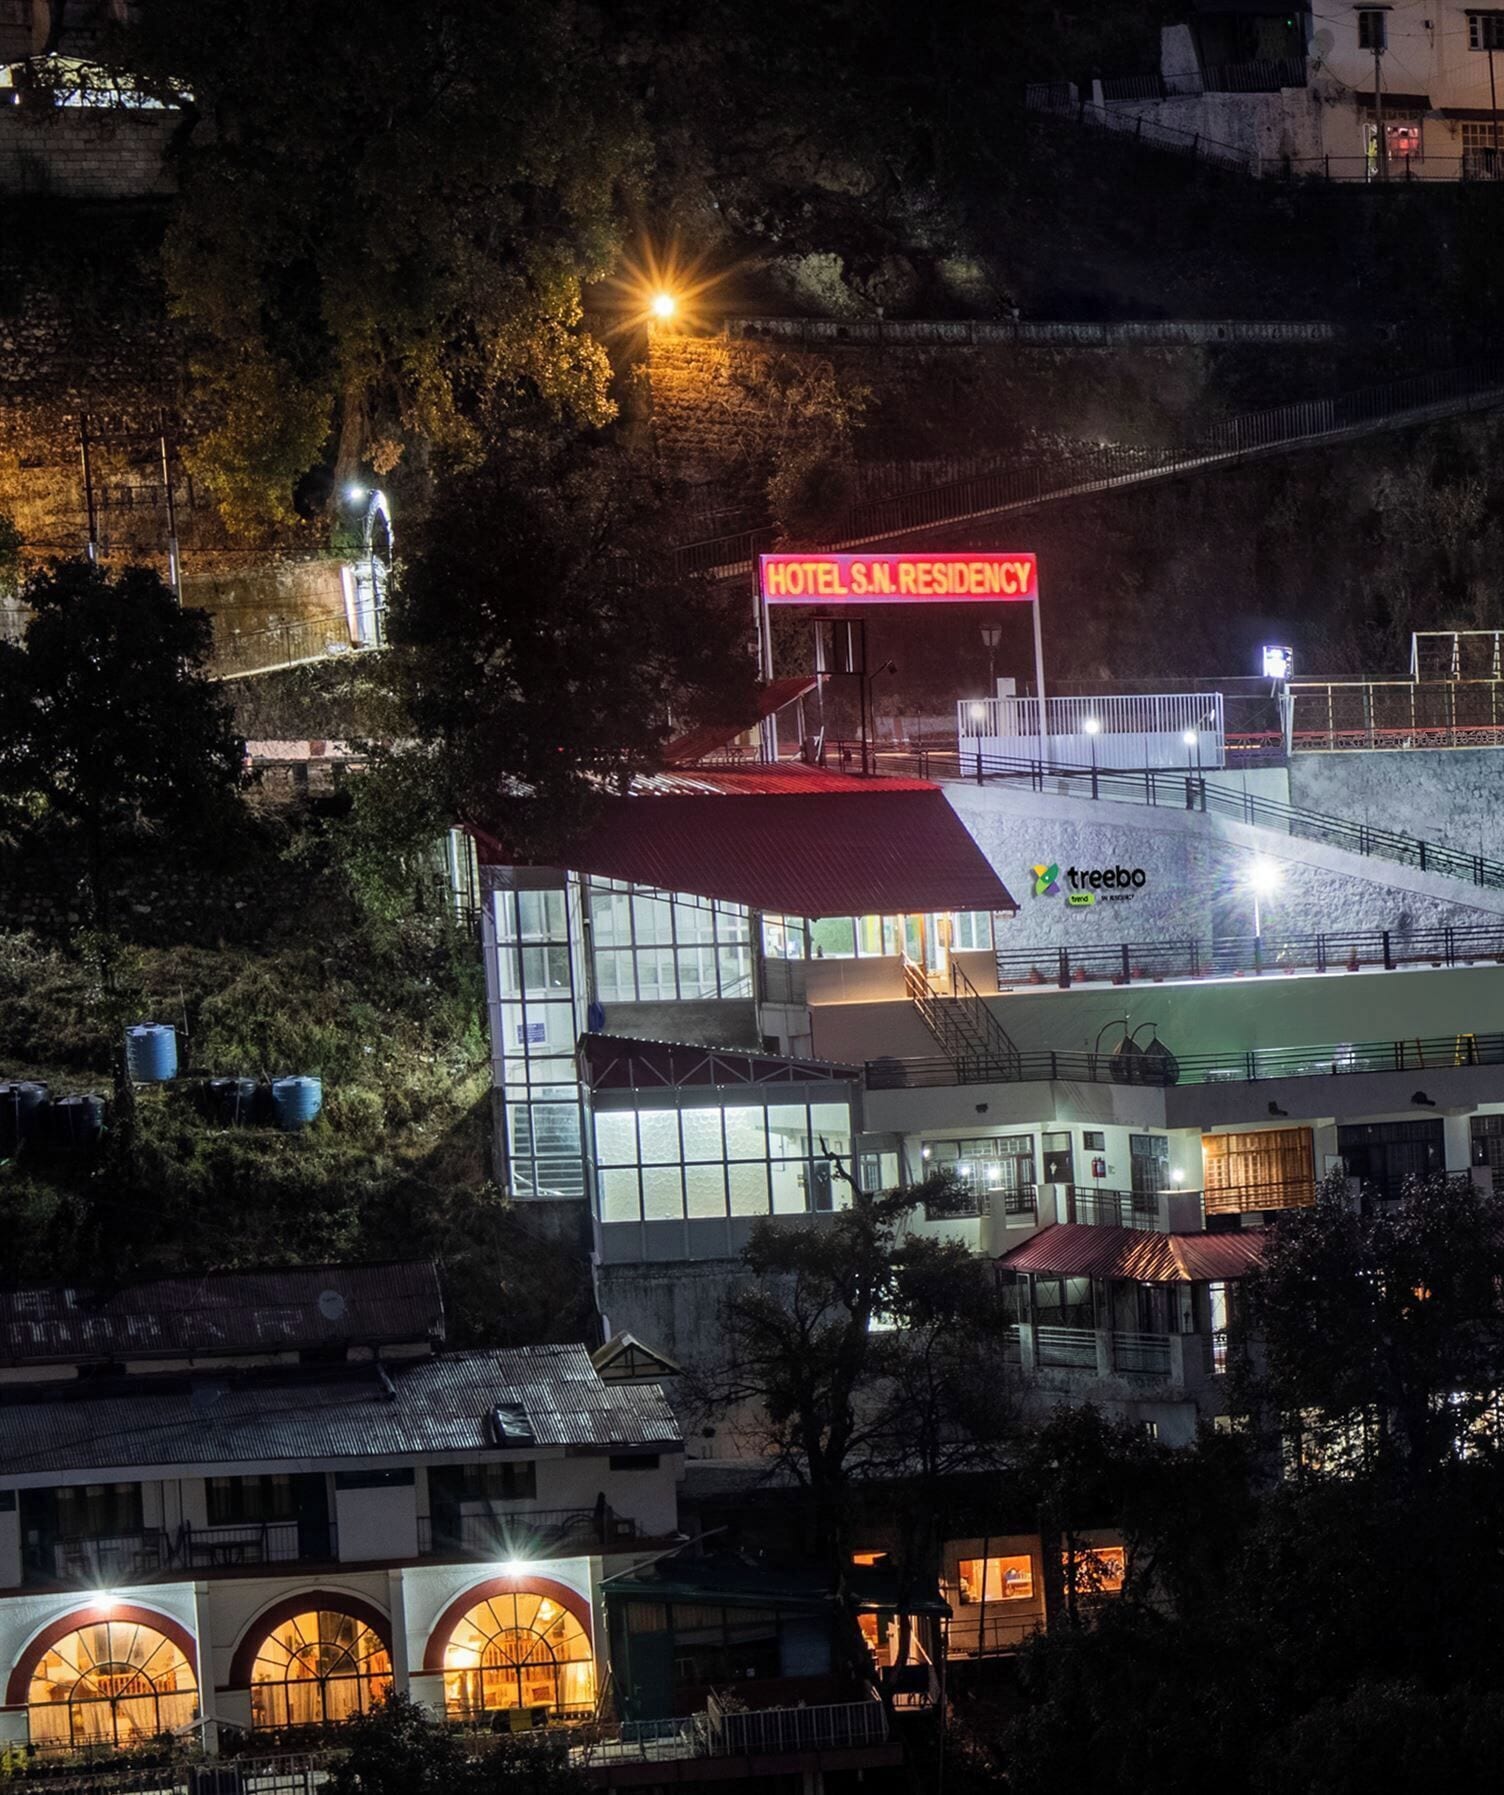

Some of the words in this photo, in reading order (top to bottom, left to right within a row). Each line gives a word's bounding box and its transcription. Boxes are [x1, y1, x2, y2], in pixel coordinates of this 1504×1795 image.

[767, 562, 848, 594] HOTEL
[851, 562, 896, 594] S.N.
[899, 562, 1031, 594] RESIDENCY
[1067, 865, 1146, 889] treebo
